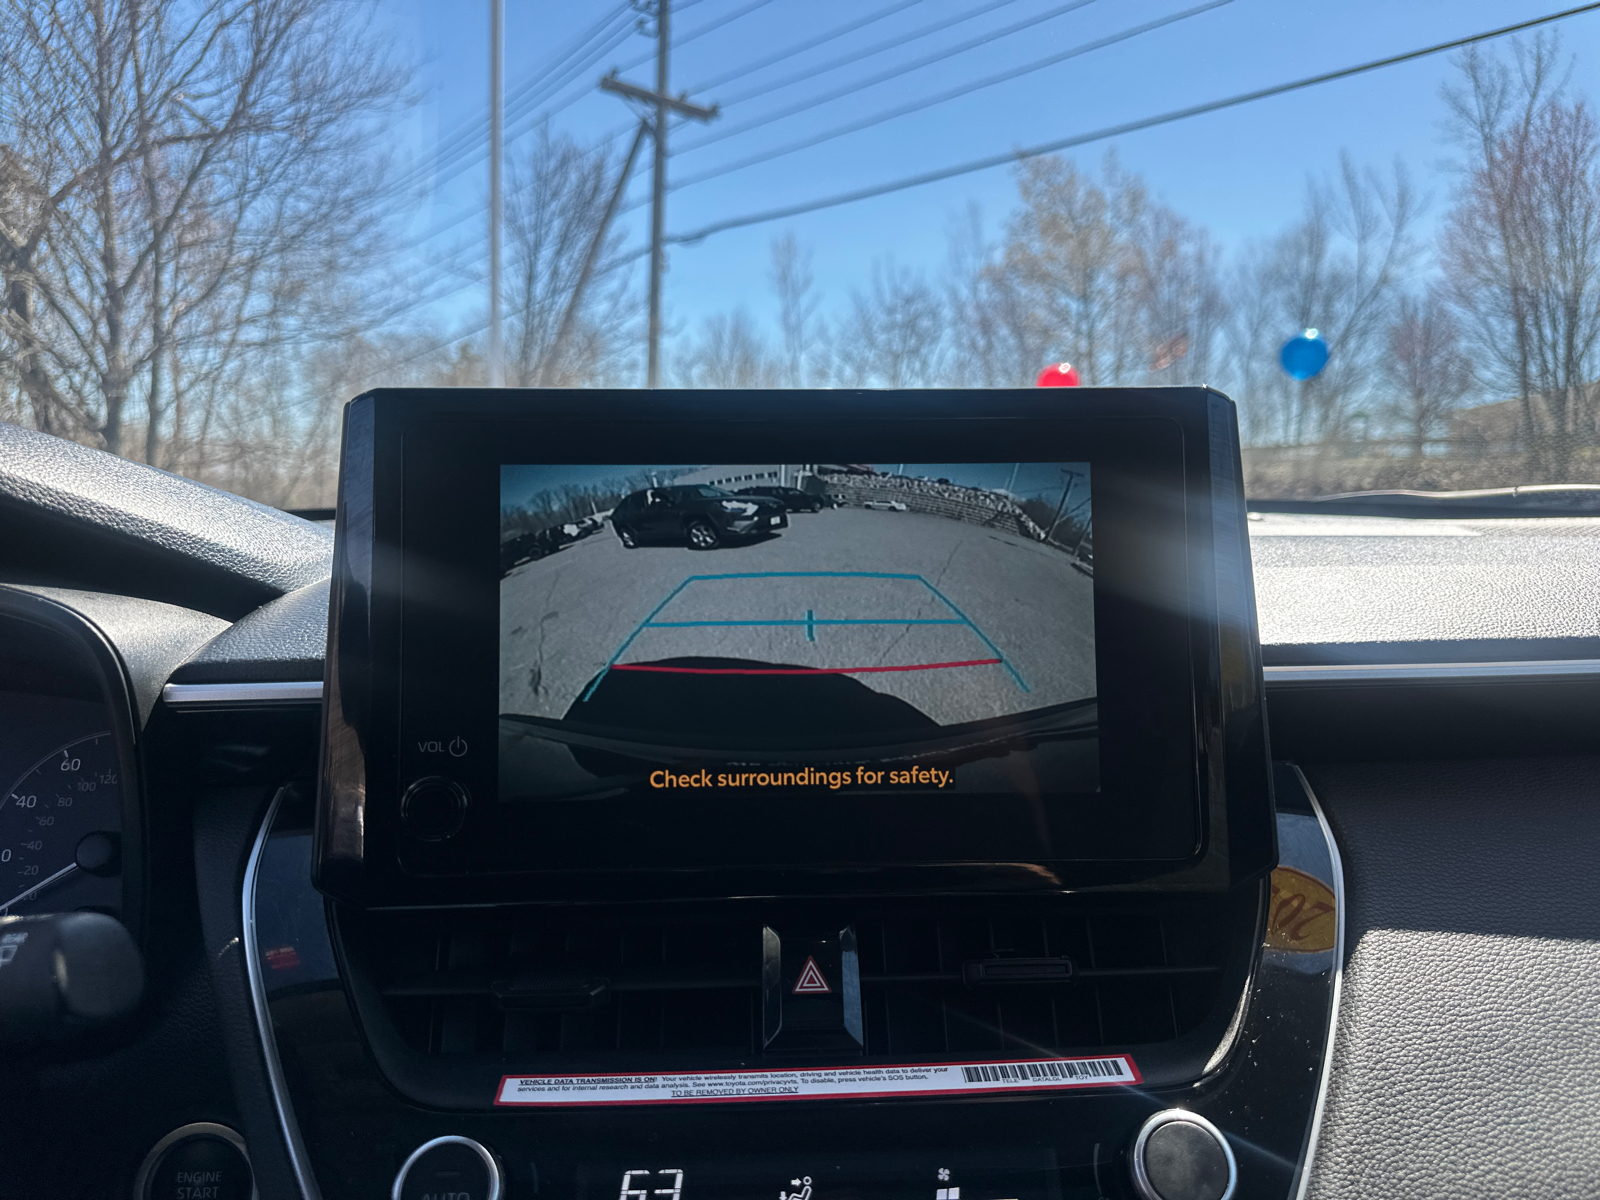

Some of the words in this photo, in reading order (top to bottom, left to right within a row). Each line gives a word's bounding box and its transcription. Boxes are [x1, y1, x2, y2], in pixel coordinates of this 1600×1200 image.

[417, 741, 445, 753] VOL
[61, 758, 81, 771] 60
[99, 774, 118, 785] 120
[649, 768, 713, 788] Check
[717, 767, 852, 789] surroundings
[856, 766, 885, 784] for
[889, 766, 954, 788] safety.
[77, 782, 97, 792] 100
[16, 795, 37, 808] 40
[57, 797, 73, 807] 80
[38, 816, 55, 826] 60
[26, 840, 43, 850] 40
[23, 865, 39, 876] 20
[770, 1072, 799, 1080] location,
[661, 1082, 689, 1090] analysis.
[177, 1171, 223, 1183] ENGINE
[177, 1186, 220, 1200] START
